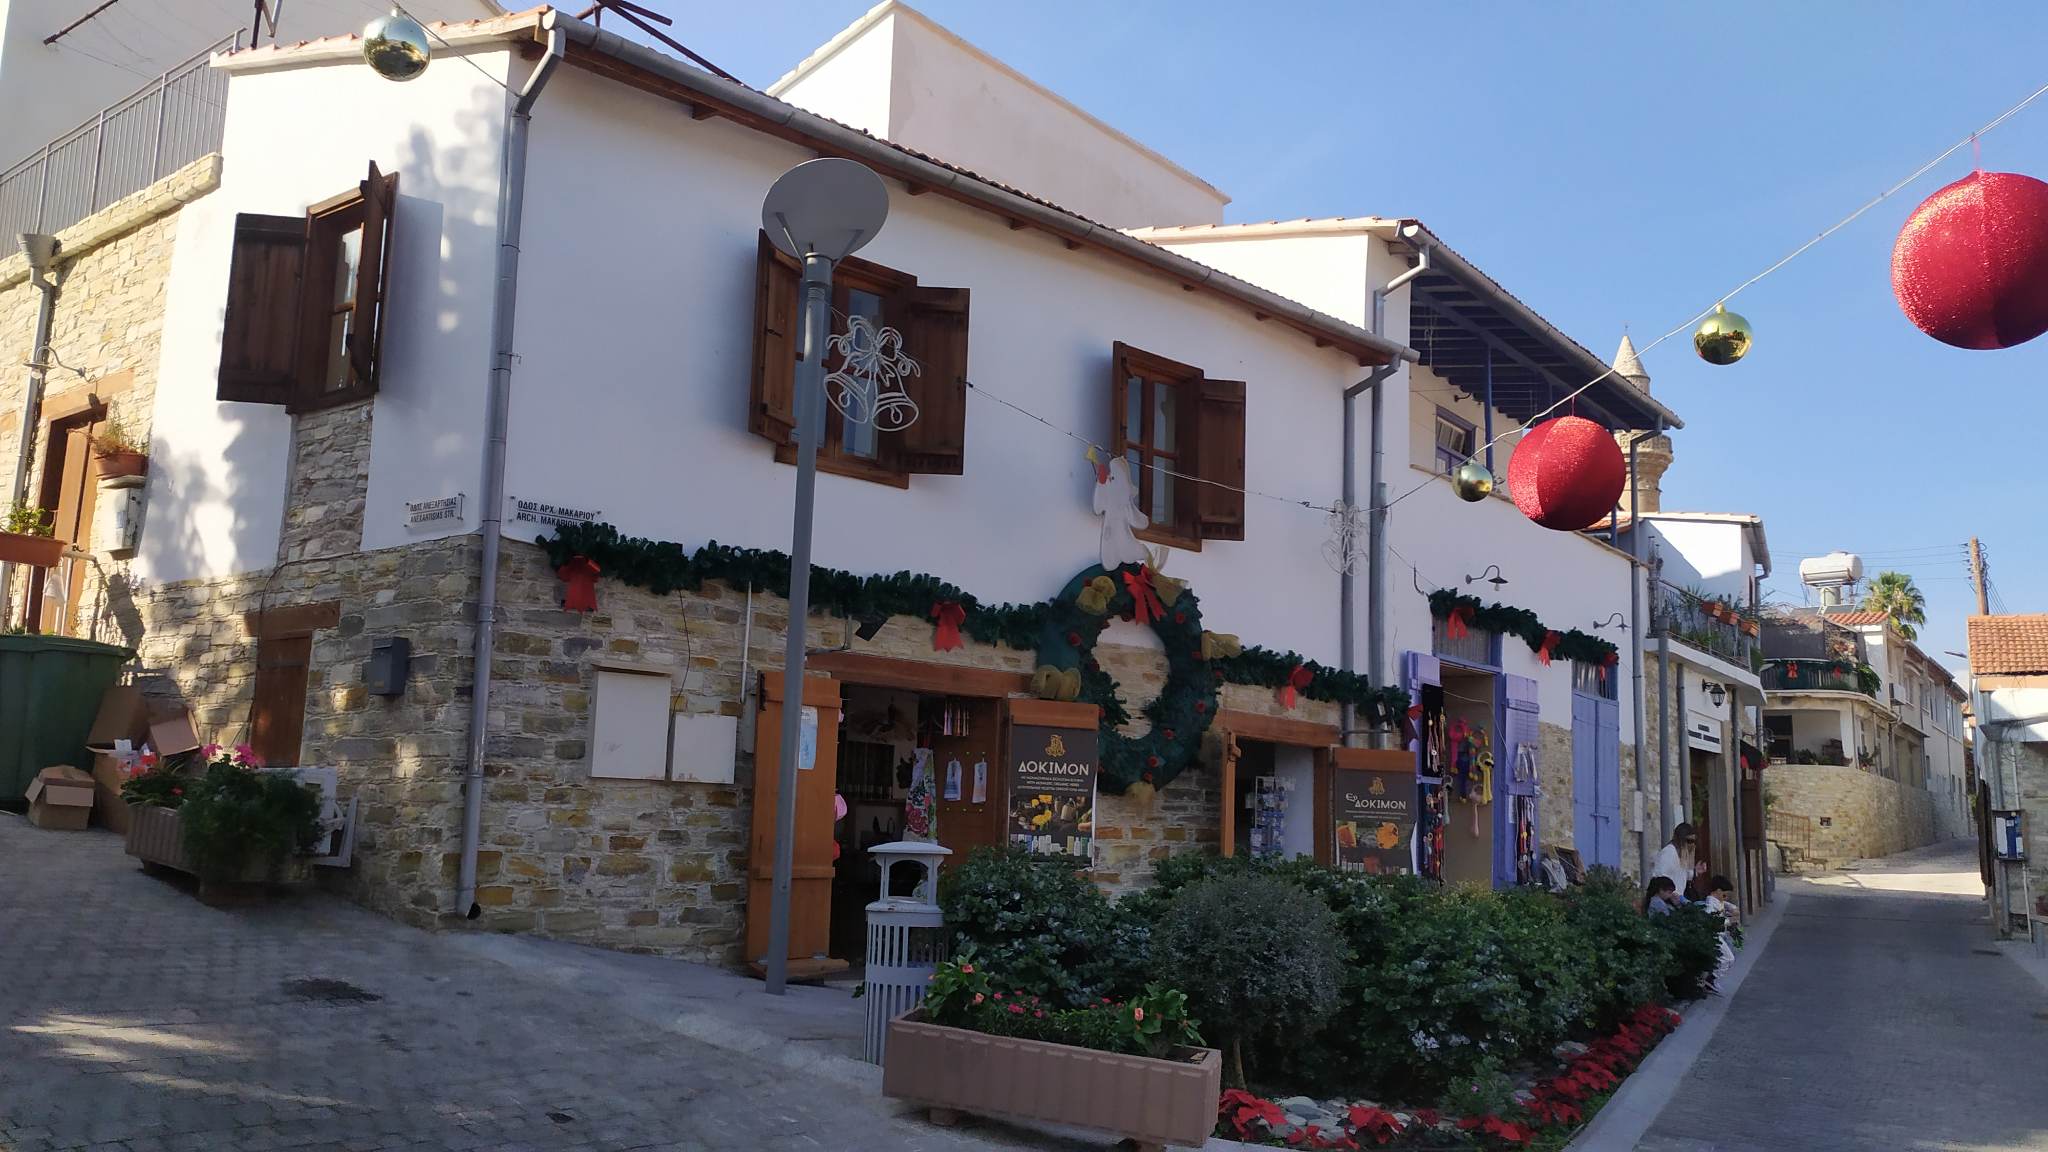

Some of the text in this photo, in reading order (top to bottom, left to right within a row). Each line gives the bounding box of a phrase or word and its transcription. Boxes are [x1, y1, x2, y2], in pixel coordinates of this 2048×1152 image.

[517, 512, 538, 523] ARCH.
[518, 500, 595, 521] ΟΔΟΣ ΑΡΧ. ΜΑΚΑΡΙΟΥ
